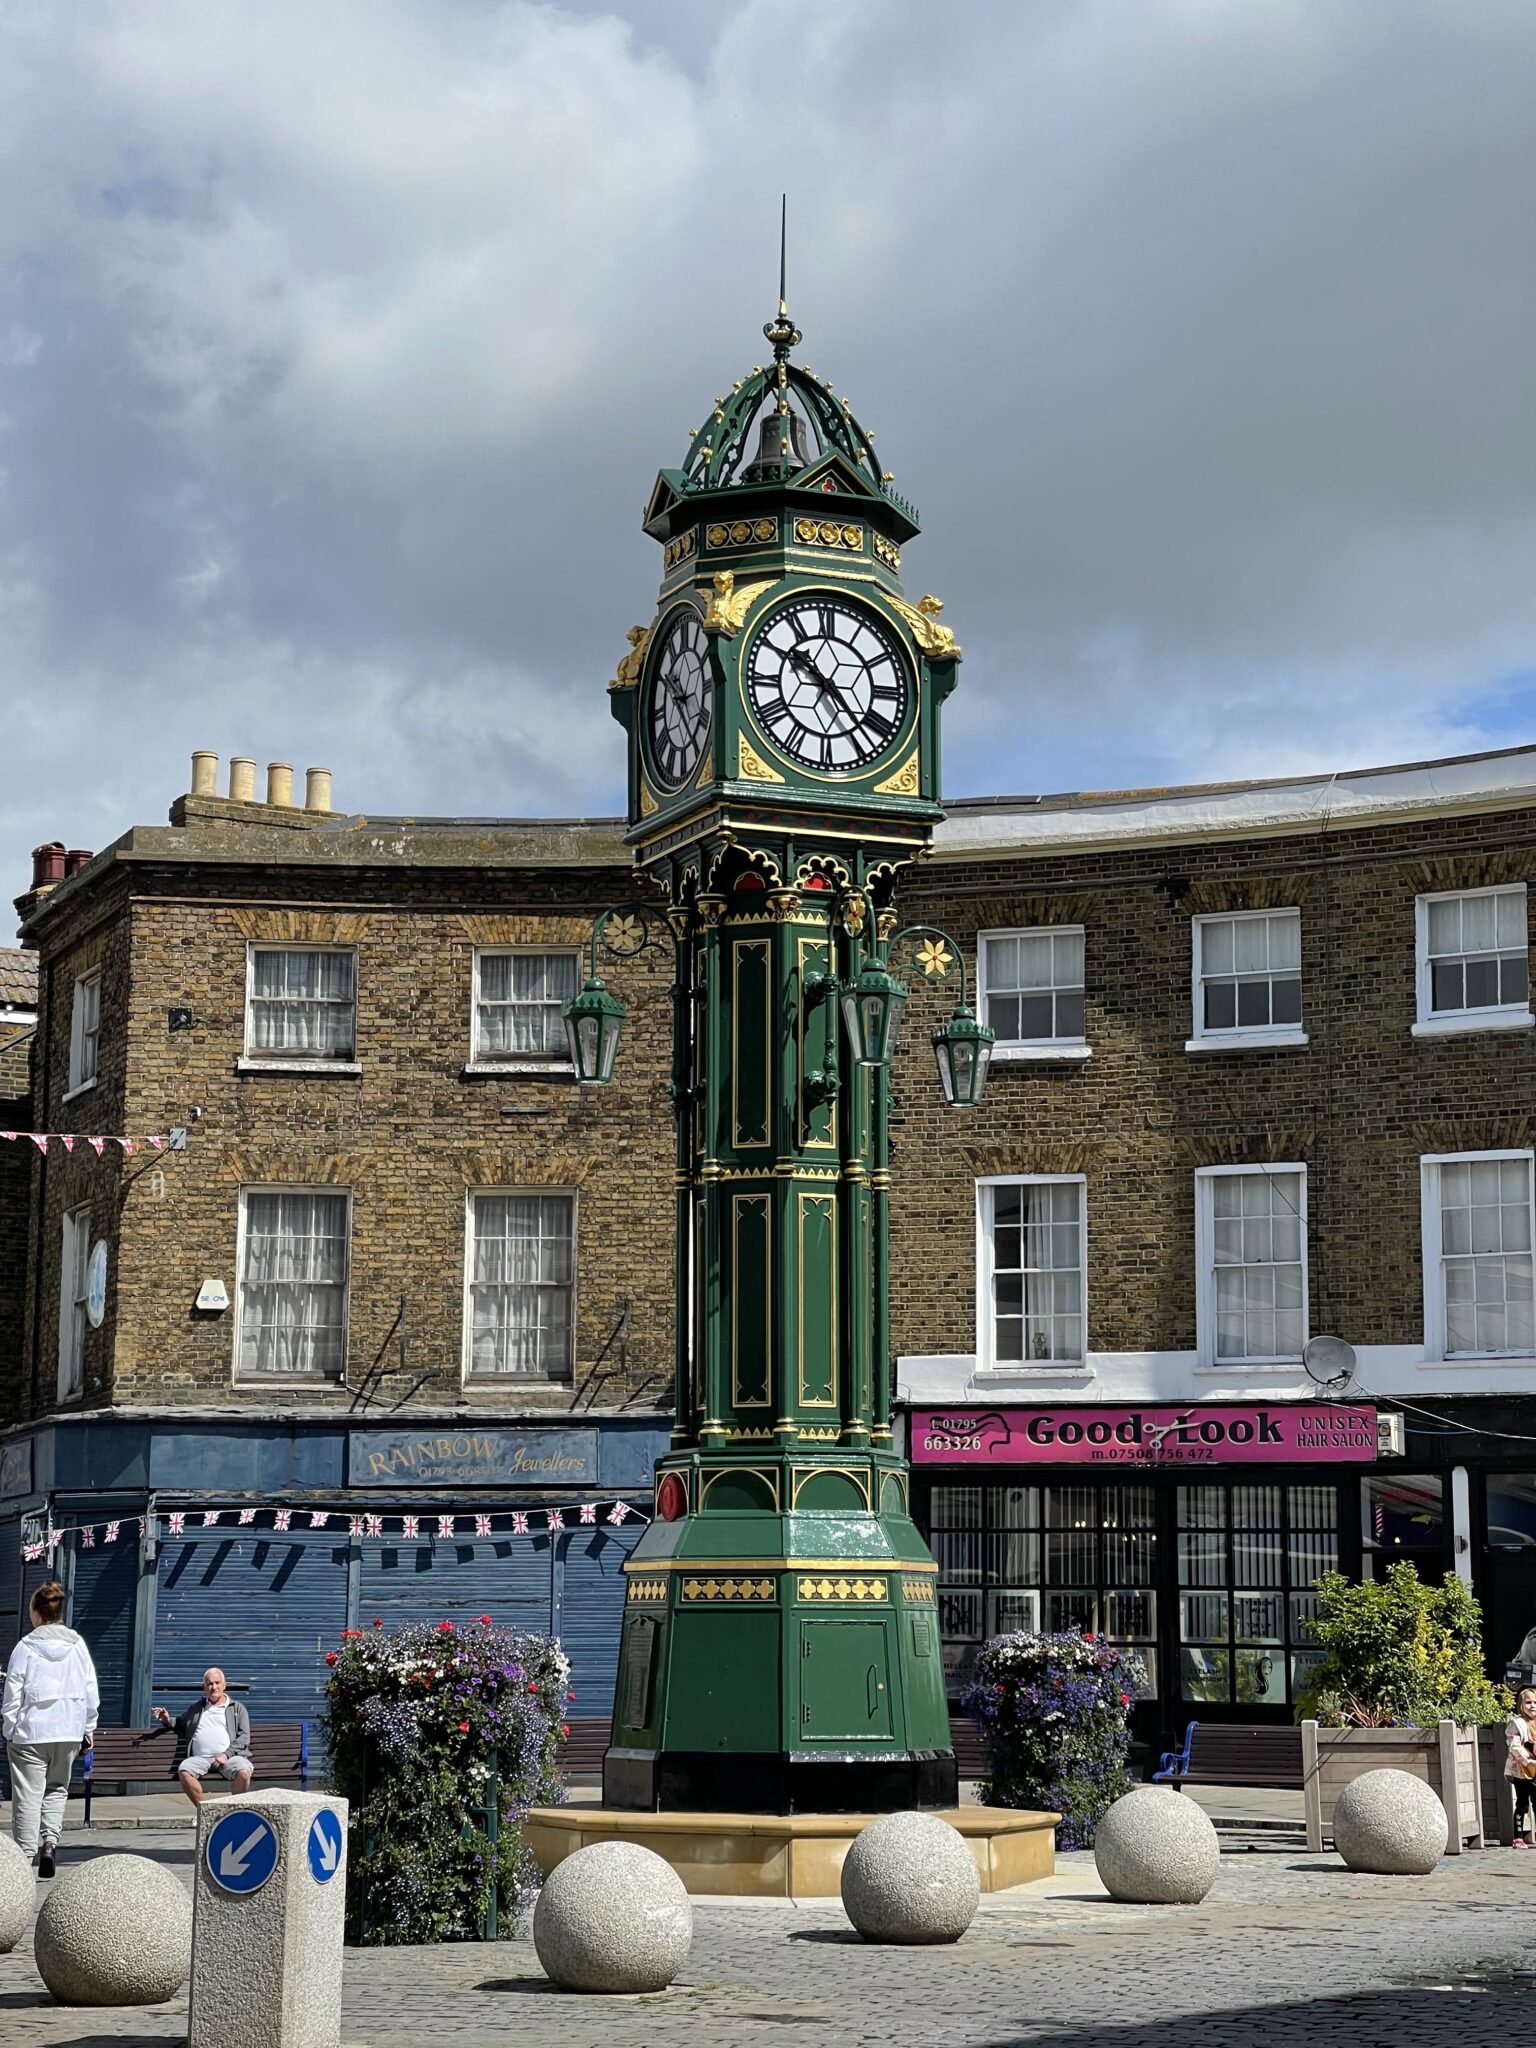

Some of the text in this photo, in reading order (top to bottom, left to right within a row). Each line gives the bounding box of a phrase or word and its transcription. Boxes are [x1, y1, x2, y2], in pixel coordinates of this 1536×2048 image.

[942, 1418, 977, 1429] 01795
[1026, 1412, 1284, 1446] Good Look
[1300, 1416, 1369, 1431] UNISEX
[923, 1436, 982, 1451] 663326
[1296, 1433, 1329, 1448] HAIR
[1331, 1432, 1373, 1447] SALON
[368, 1437, 585, 1476] RAINBOW Jewellers
[1091, 1448, 1213, 1460] m.07508 756 472
